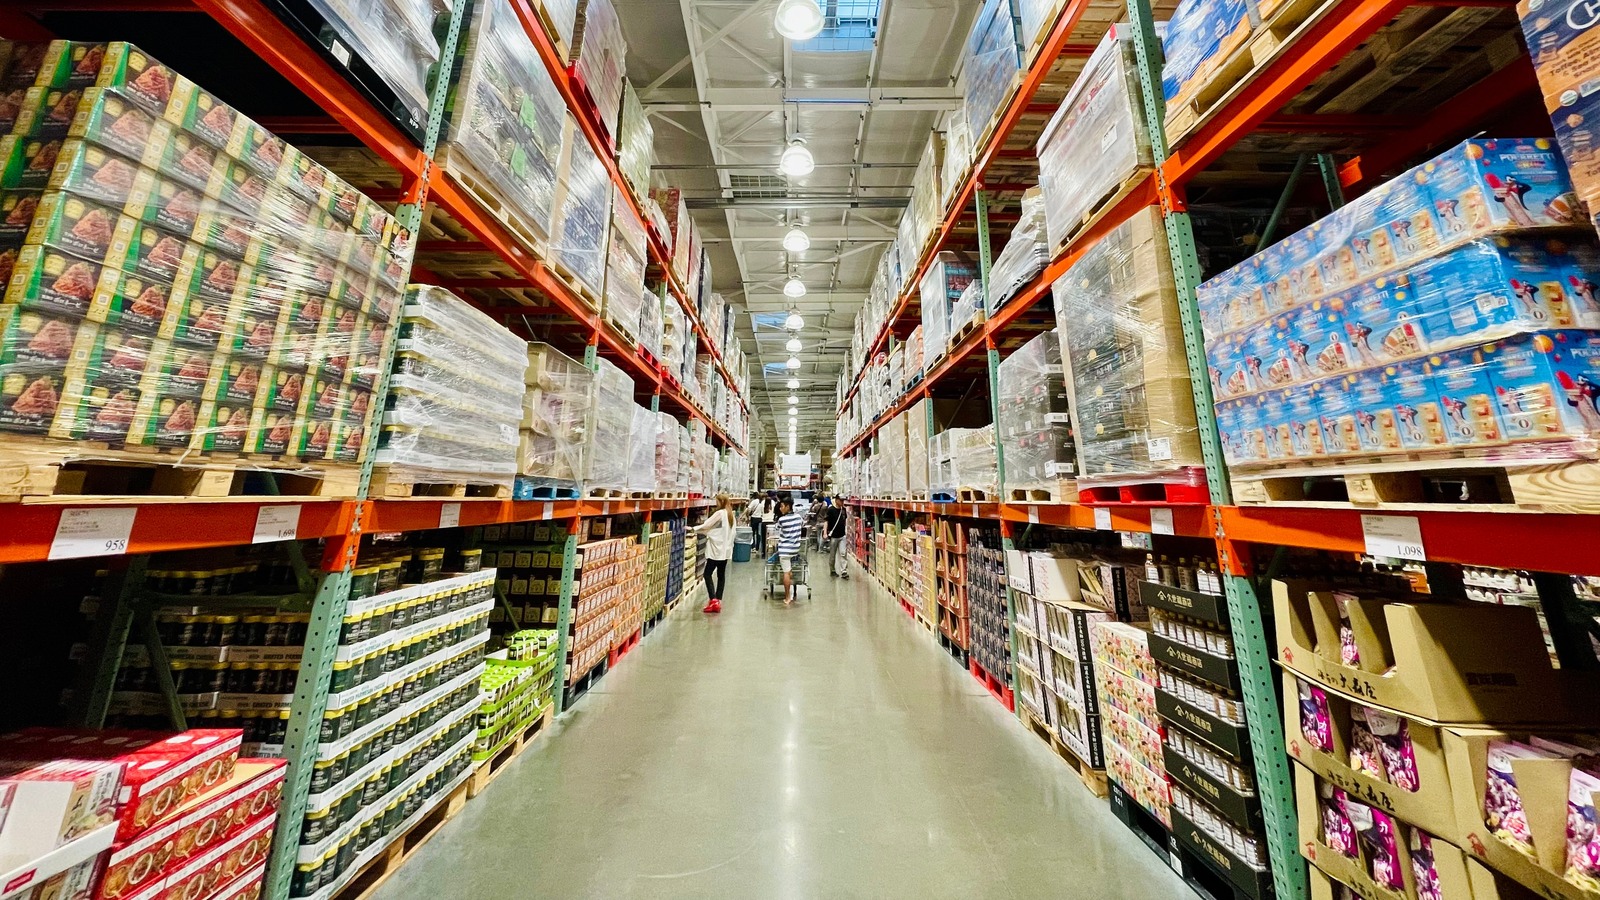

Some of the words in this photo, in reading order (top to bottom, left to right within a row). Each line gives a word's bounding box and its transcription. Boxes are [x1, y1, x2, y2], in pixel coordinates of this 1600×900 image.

[278, 529, 295, 538] 1,698
[104, 539, 126, 552] 958
[1397, 545, 1423, 557] 1,098
[1166, 593, 1193, 608] 久世福商店
[1175, 649, 1203, 669] 久世福商店
[1184, 710, 1213, 734] 久世福商店
